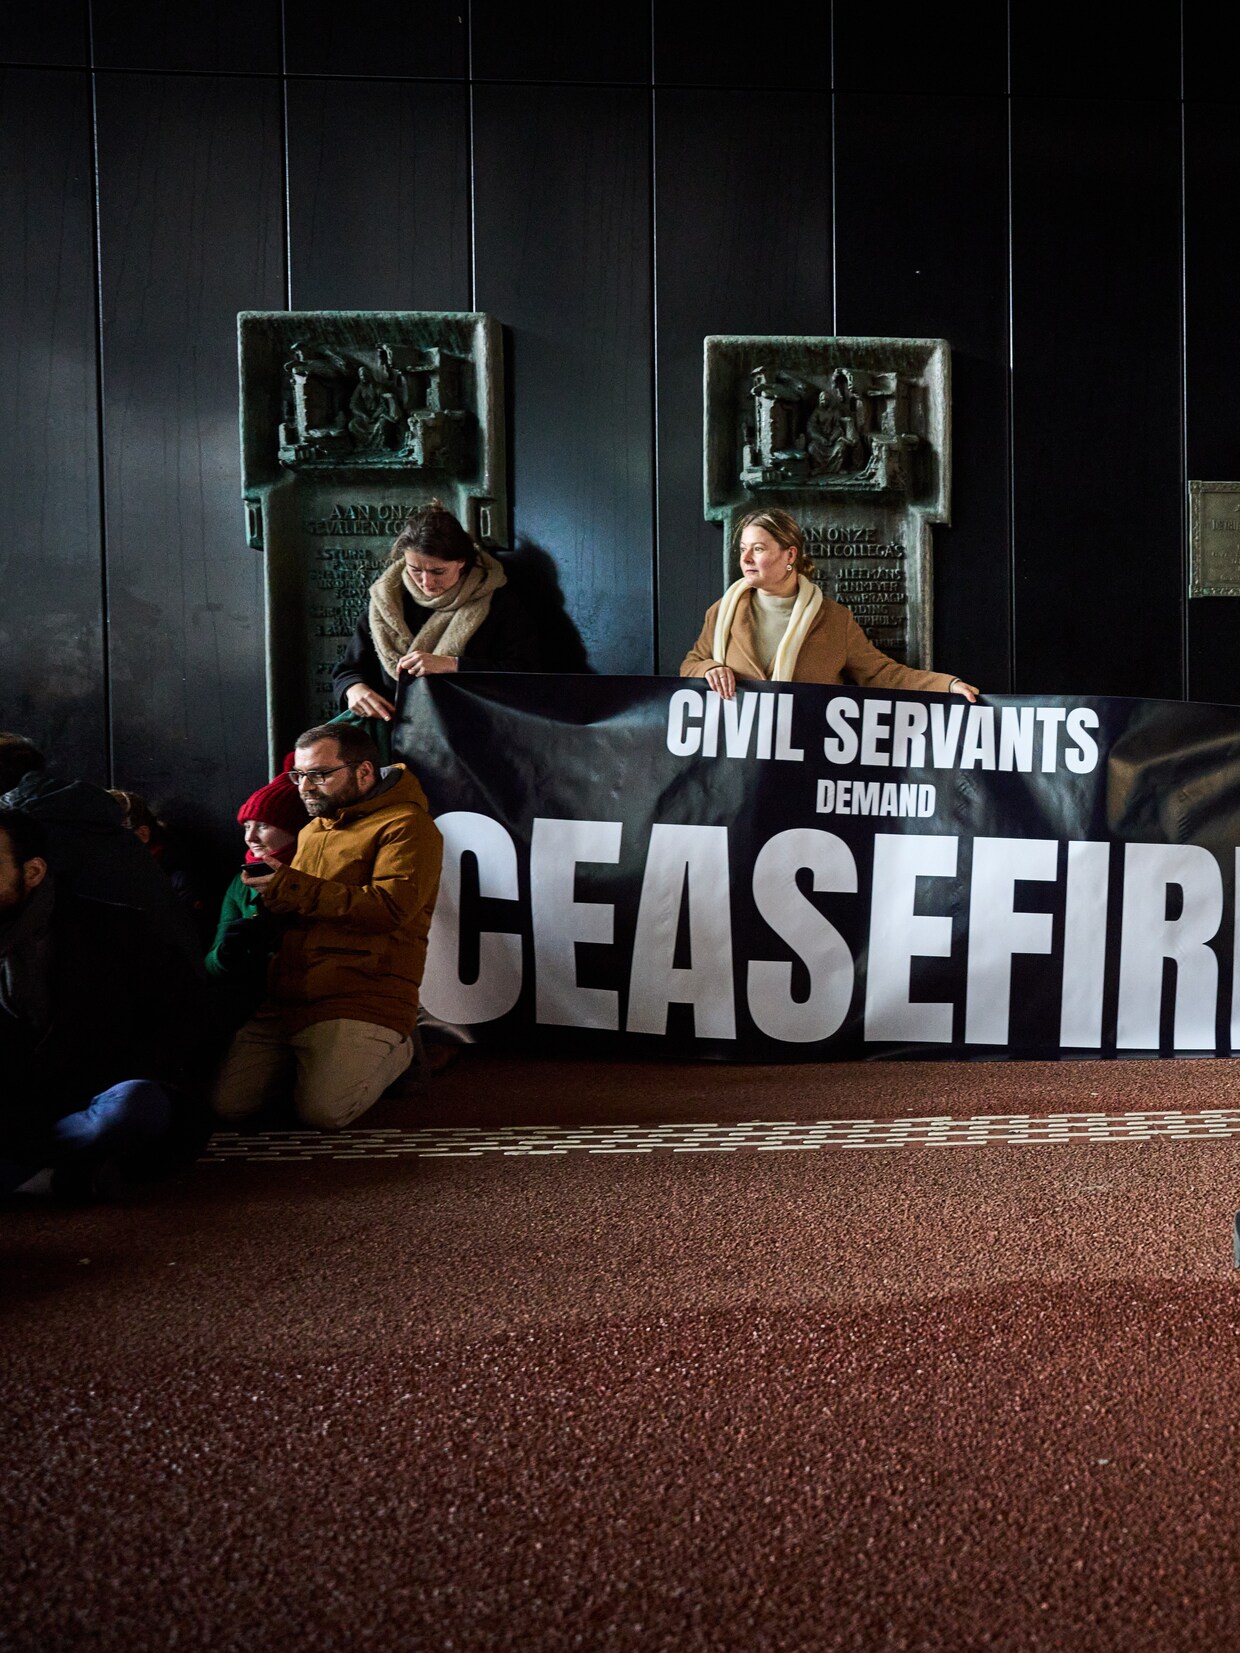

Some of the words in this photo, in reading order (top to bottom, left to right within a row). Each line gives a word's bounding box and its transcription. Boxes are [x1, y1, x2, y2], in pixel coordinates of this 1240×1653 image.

[329, 504, 370, 520] AAN
[800, 526, 823, 542] AN
[826, 526, 878, 542] ONZE
[666, 688, 805, 762] CIVIL
[824, 696, 1099, 774] SERVANTS
[816, 779, 936, 818] DEMAND
